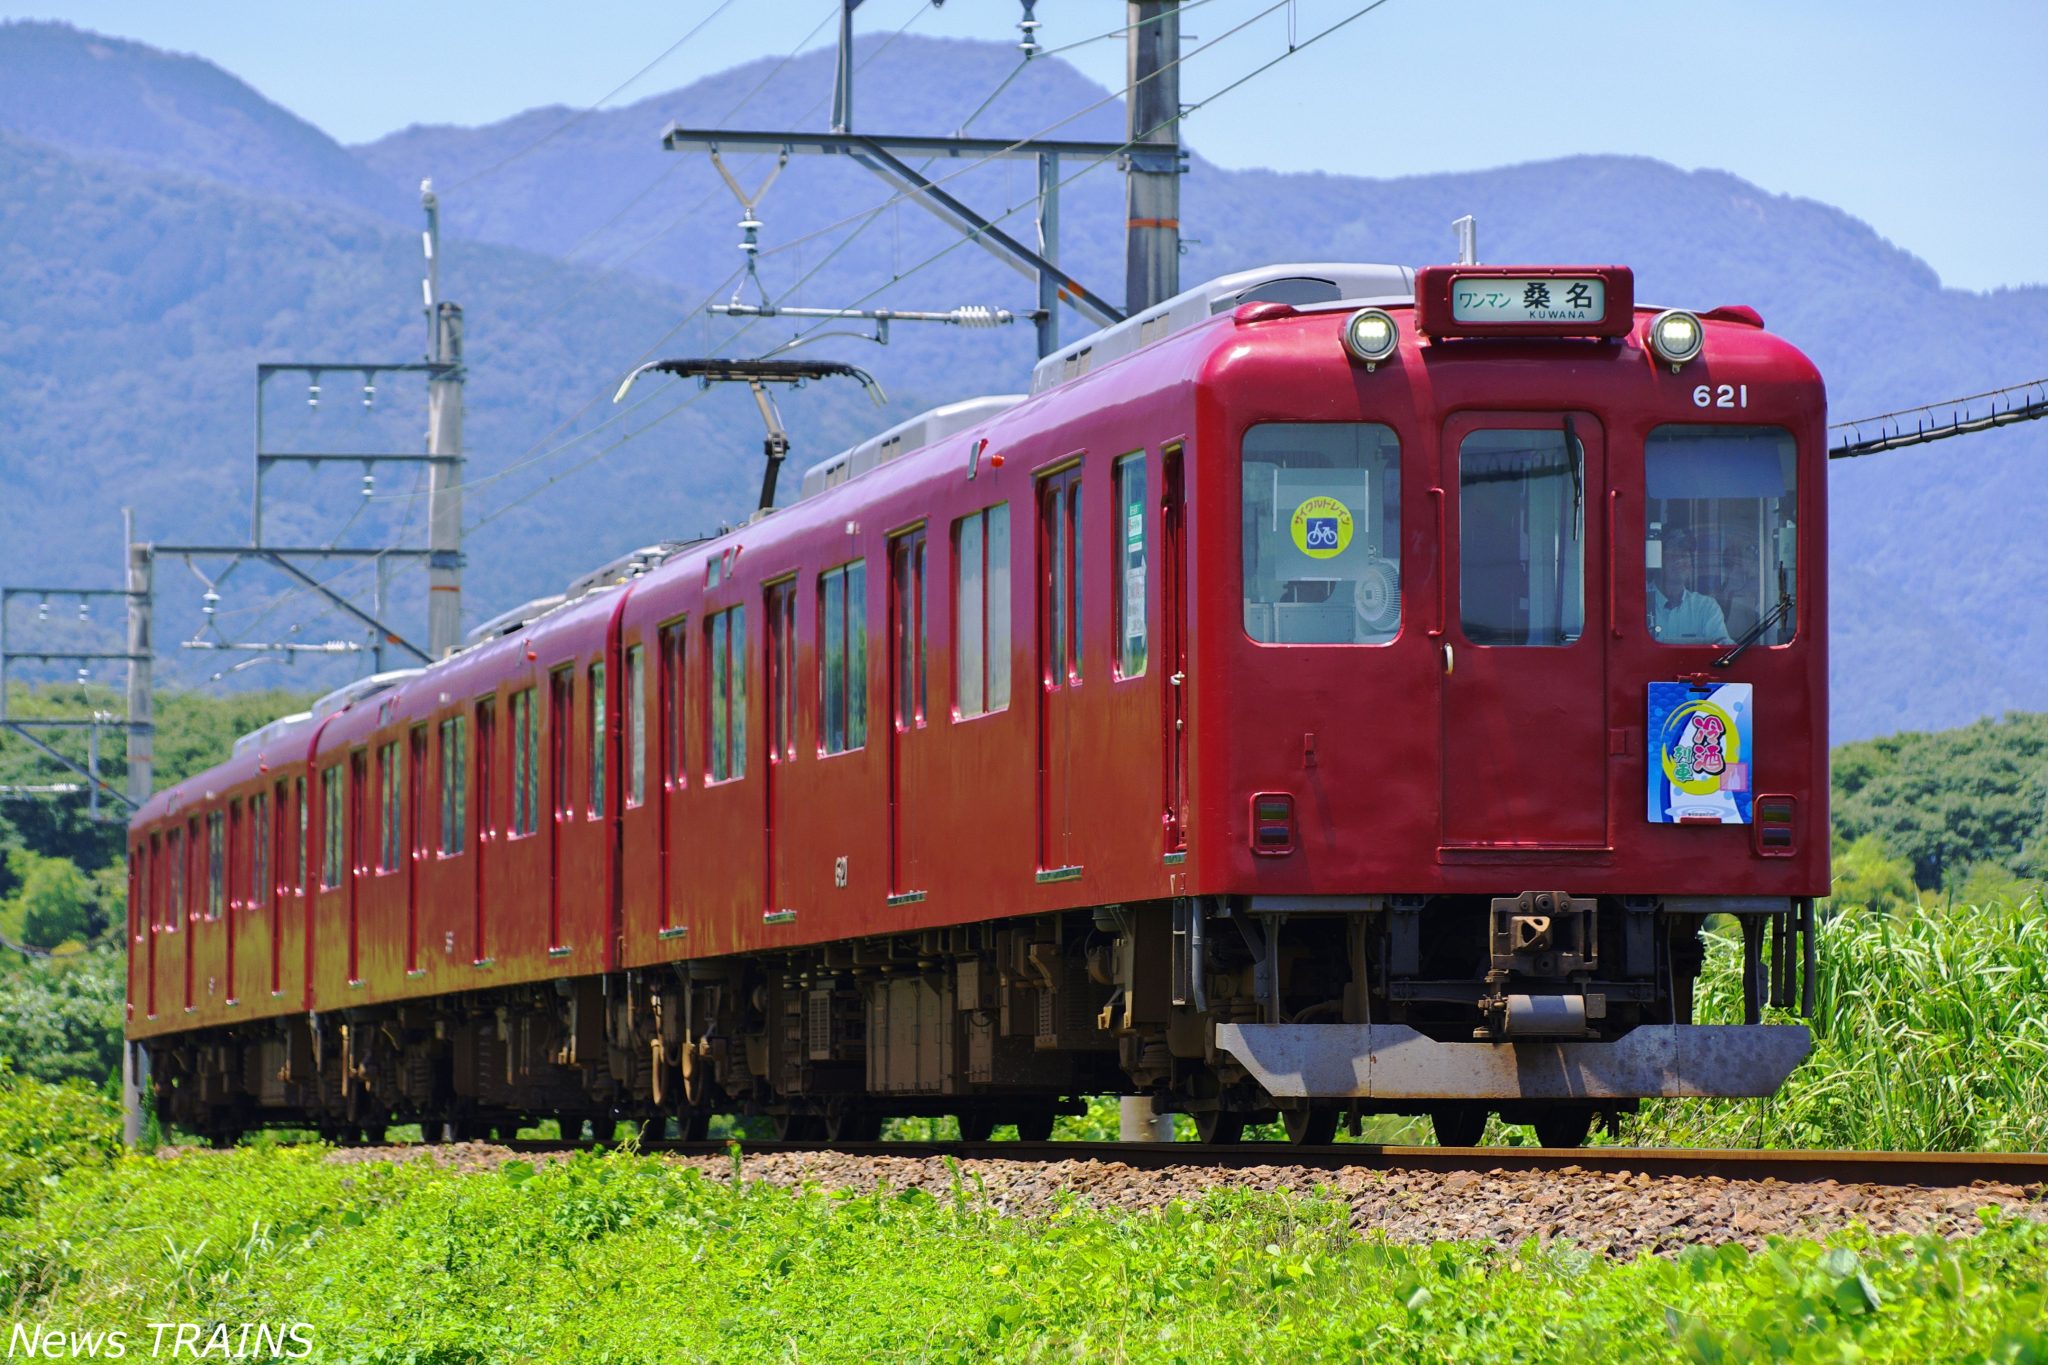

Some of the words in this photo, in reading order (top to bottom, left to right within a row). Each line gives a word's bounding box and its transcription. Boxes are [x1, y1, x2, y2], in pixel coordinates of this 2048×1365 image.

[1459, 292, 1511, 309] ワンマン
[1523, 282, 1592, 309] 桑名
[1529, 310, 1585, 319] KUWANA
[1693, 384, 1747, 408] 621
[1692, 715, 1726, 775] 冷酒
[1674, 746, 1694, 782] 列車
